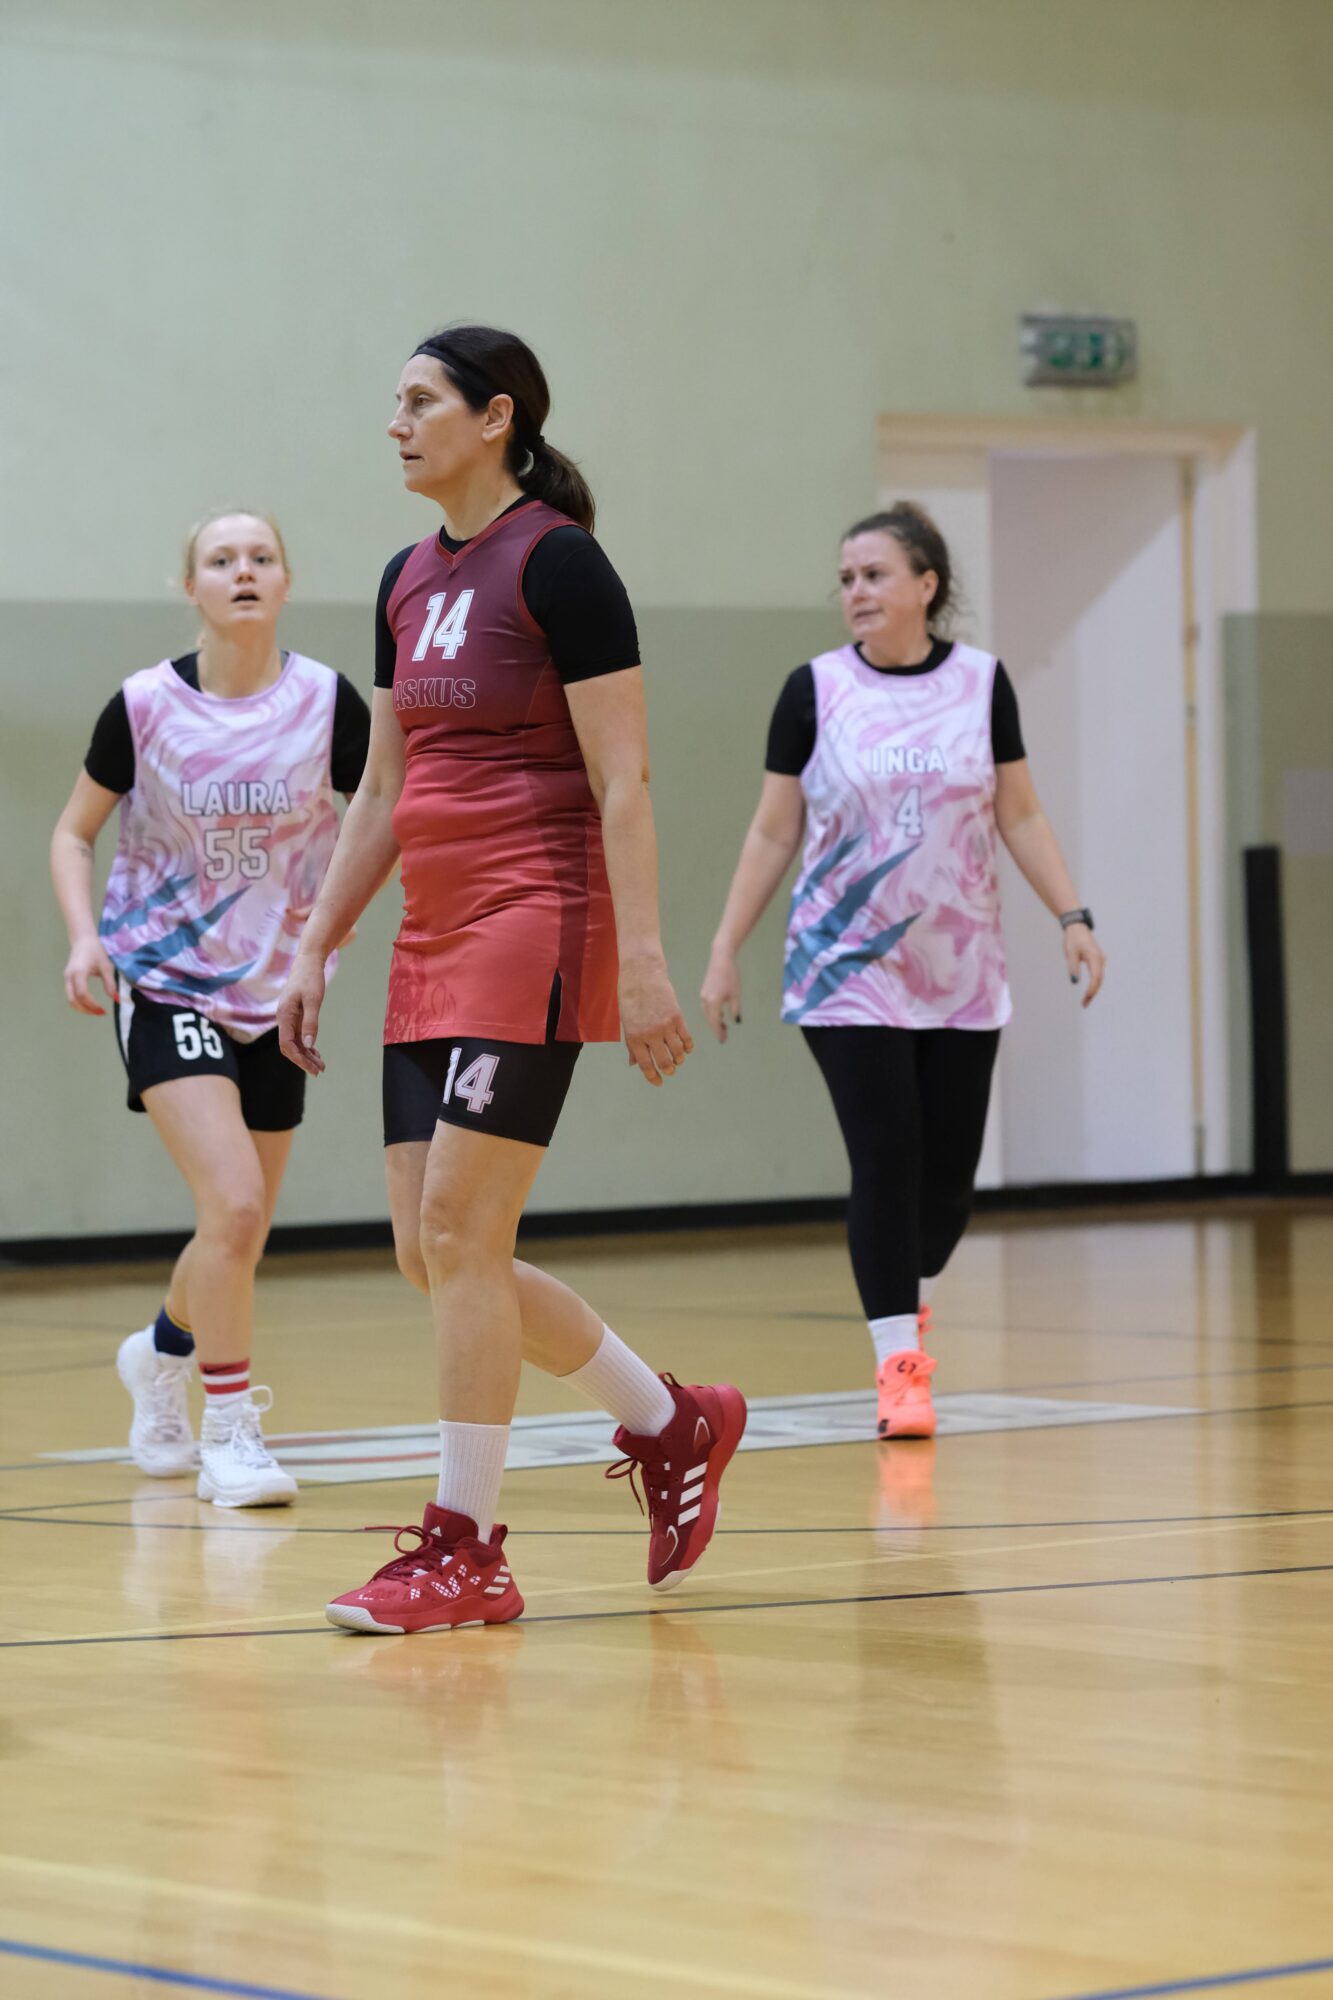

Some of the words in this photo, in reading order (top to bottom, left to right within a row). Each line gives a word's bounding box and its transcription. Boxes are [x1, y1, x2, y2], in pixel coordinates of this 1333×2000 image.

[412, 589, 475, 661] 14
[871, 746, 947, 775] INGA
[181, 779, 292, 817] LAURA
[894, 784, 924, 839] 4
[203, 826, 271, 881] 55
[172, 1012, 224, 1060] 55
